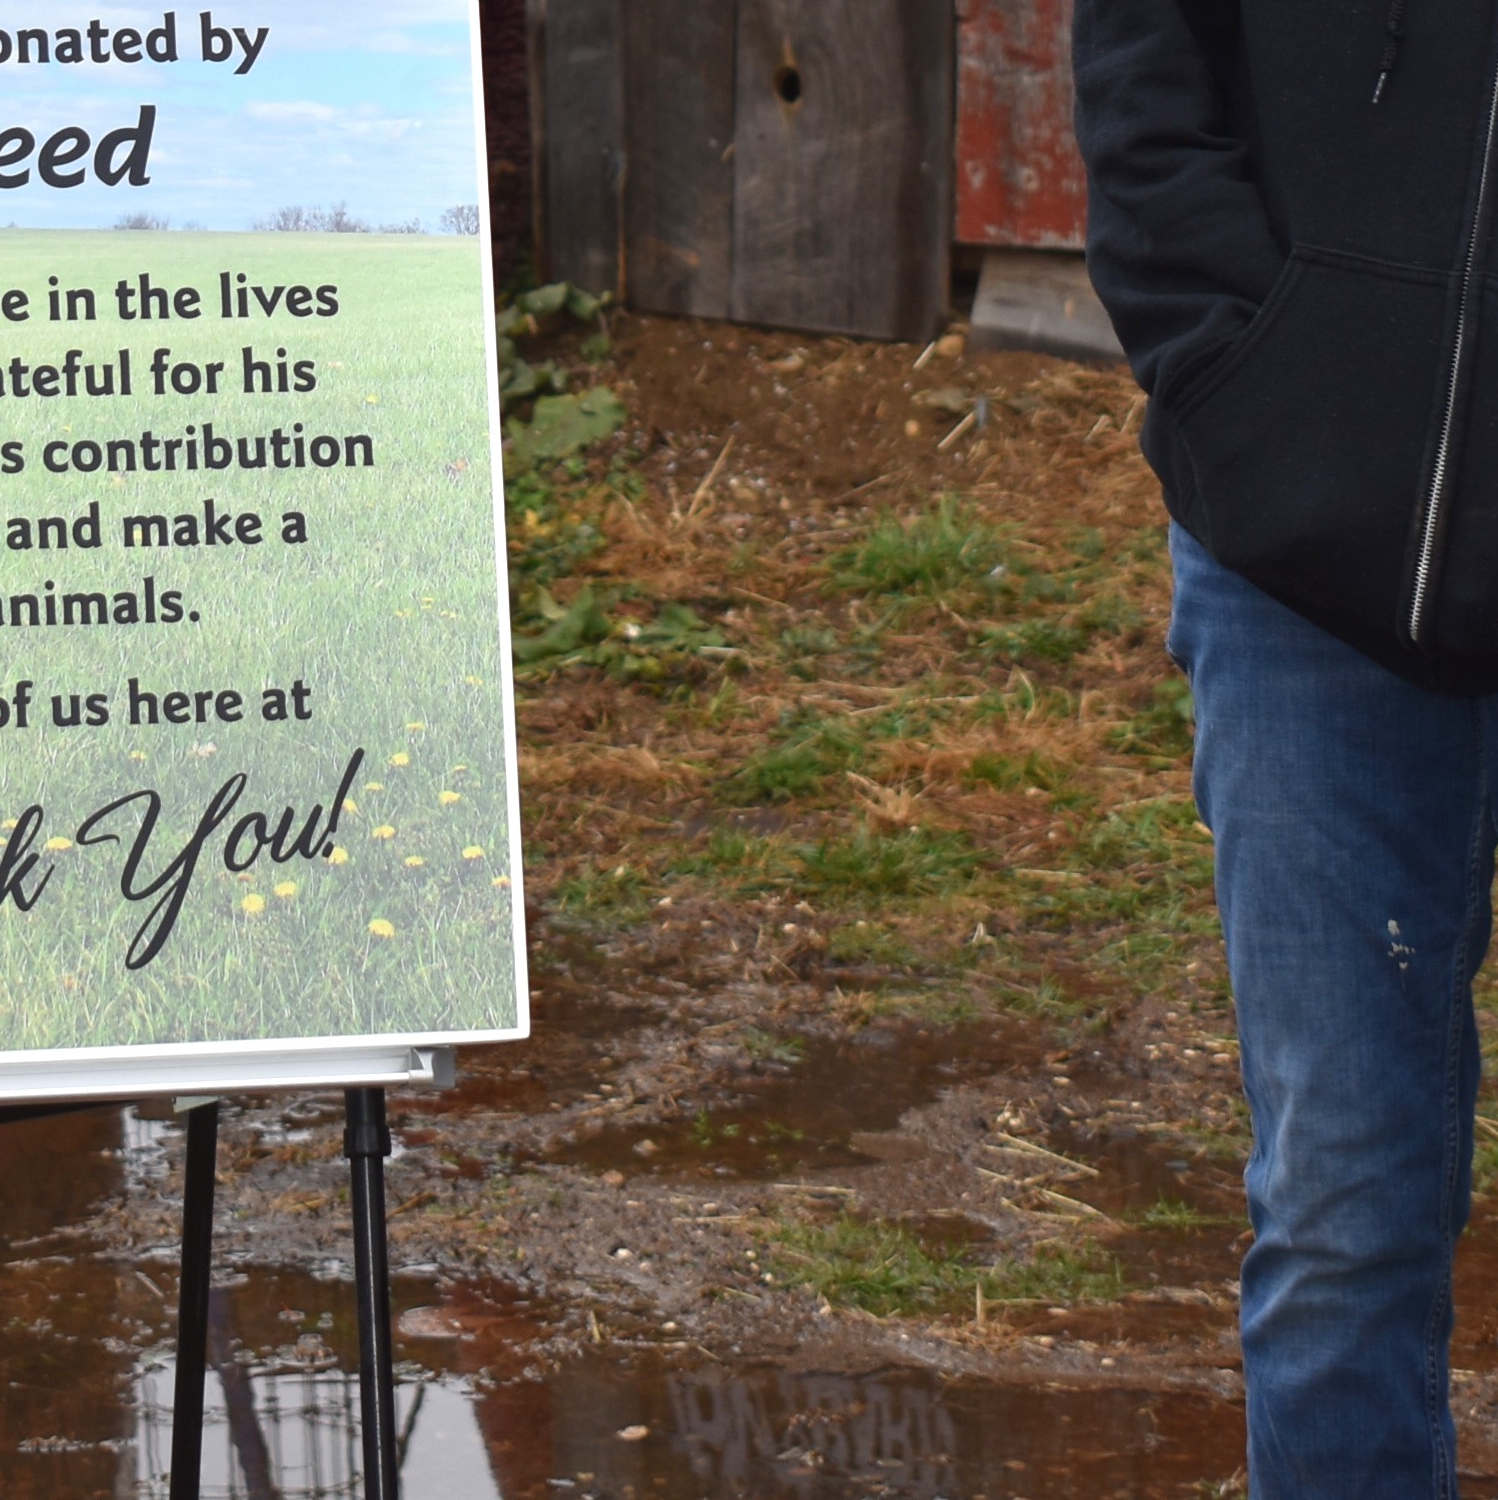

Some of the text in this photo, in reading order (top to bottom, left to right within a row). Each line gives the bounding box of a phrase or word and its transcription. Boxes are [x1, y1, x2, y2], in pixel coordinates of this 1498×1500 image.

[200, 12, 268, 74] by
[49, 277, 95, 320] in
[116, 274, 200, 319] the
[220, 272, 338, 317] lives
[151, 349, 223, 394] for
[242, 347, 315, 392] his
[44, 423, 373, 472] contribution
[7, 502, 101, 549] and
[123, 499, 262, 547] make
[282, 512, 307, 543] a
[52, 694, 108, 726] us
[128, 678, 242, 724] here
[262, 680, 312, 721] at
[76, 748, 364, 970] You!
